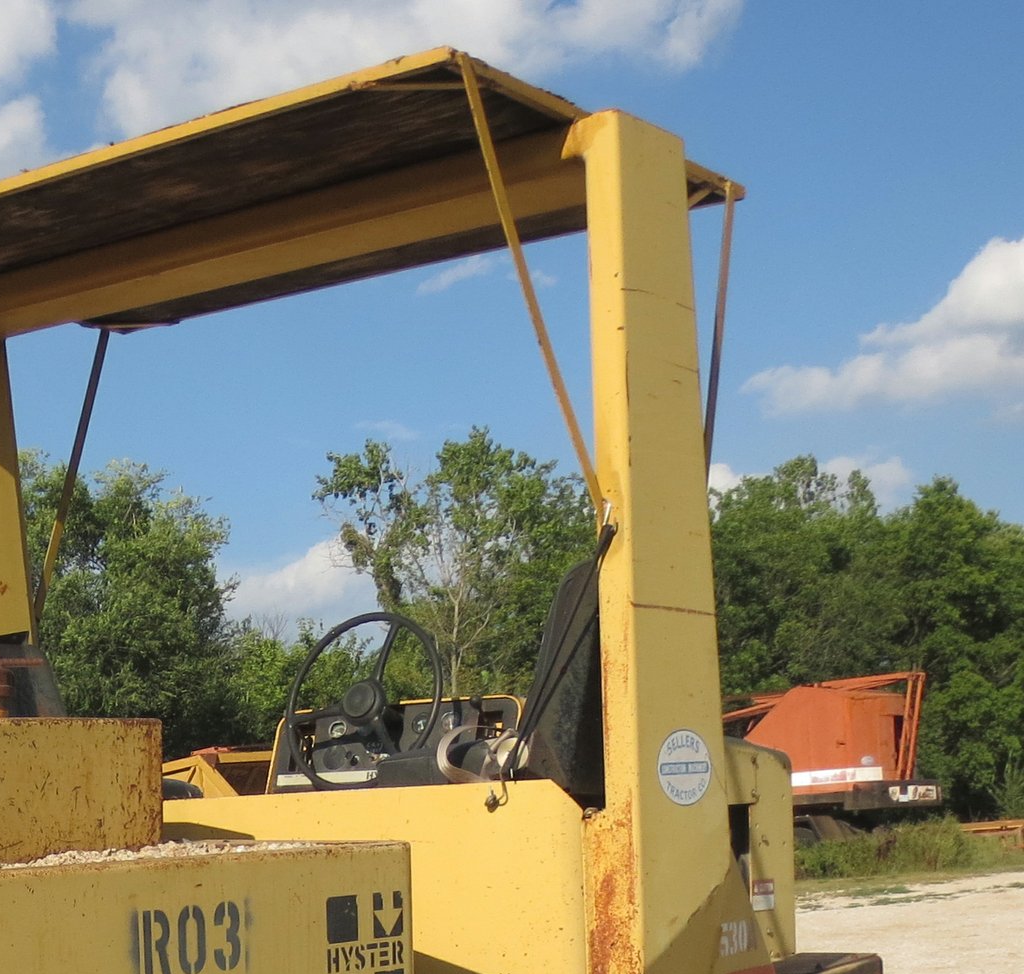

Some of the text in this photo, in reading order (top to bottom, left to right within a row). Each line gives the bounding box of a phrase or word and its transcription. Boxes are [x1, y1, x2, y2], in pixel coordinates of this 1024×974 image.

[666, 734, 700, 756] SELLERS
[666, 781, 697, 801] TRACTOR
[327, 940, 404, 974] HYSTER
